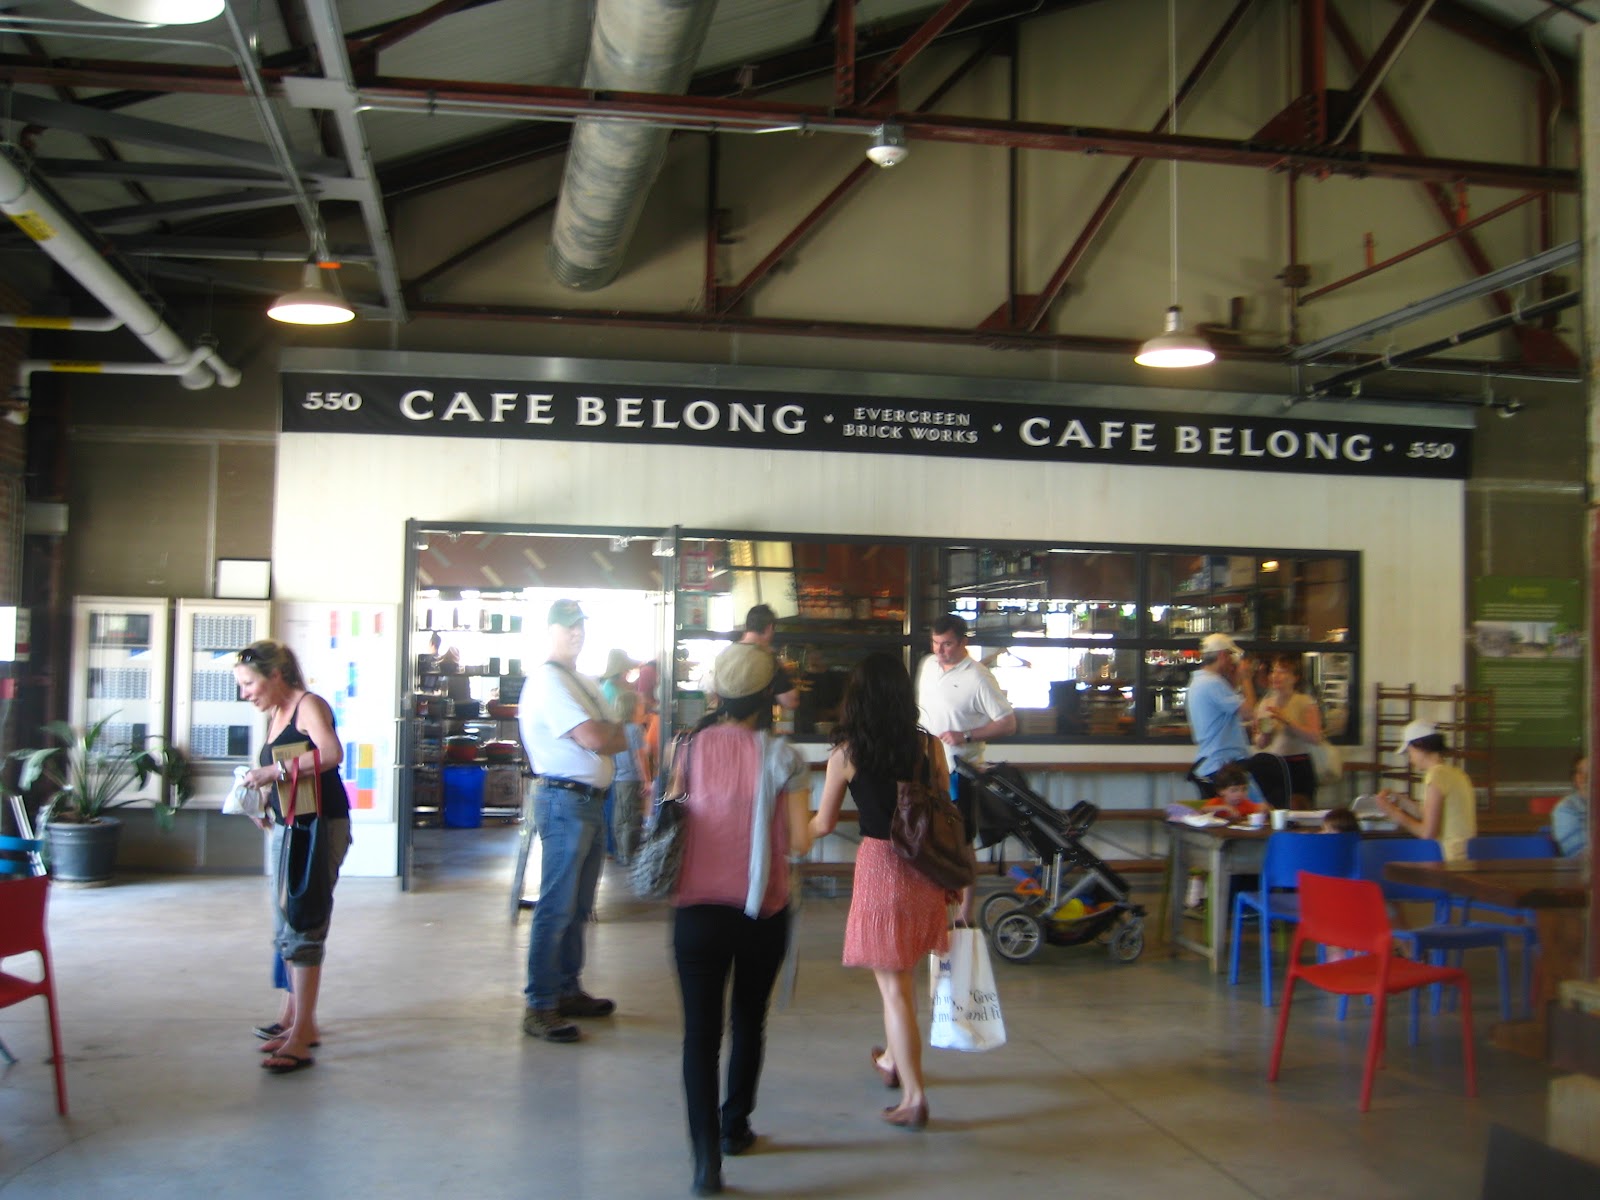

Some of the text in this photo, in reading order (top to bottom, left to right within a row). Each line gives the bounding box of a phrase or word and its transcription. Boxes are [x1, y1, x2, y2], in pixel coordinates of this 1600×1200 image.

[301, 389, 807, 435] 550 CAFE BELONG
[853, 407, 971, 427] EVERGREEN
[842, 424, 979, 445] BRICK WORKS
[1019, 417, 1455, 462] CAFE BELONG 550
